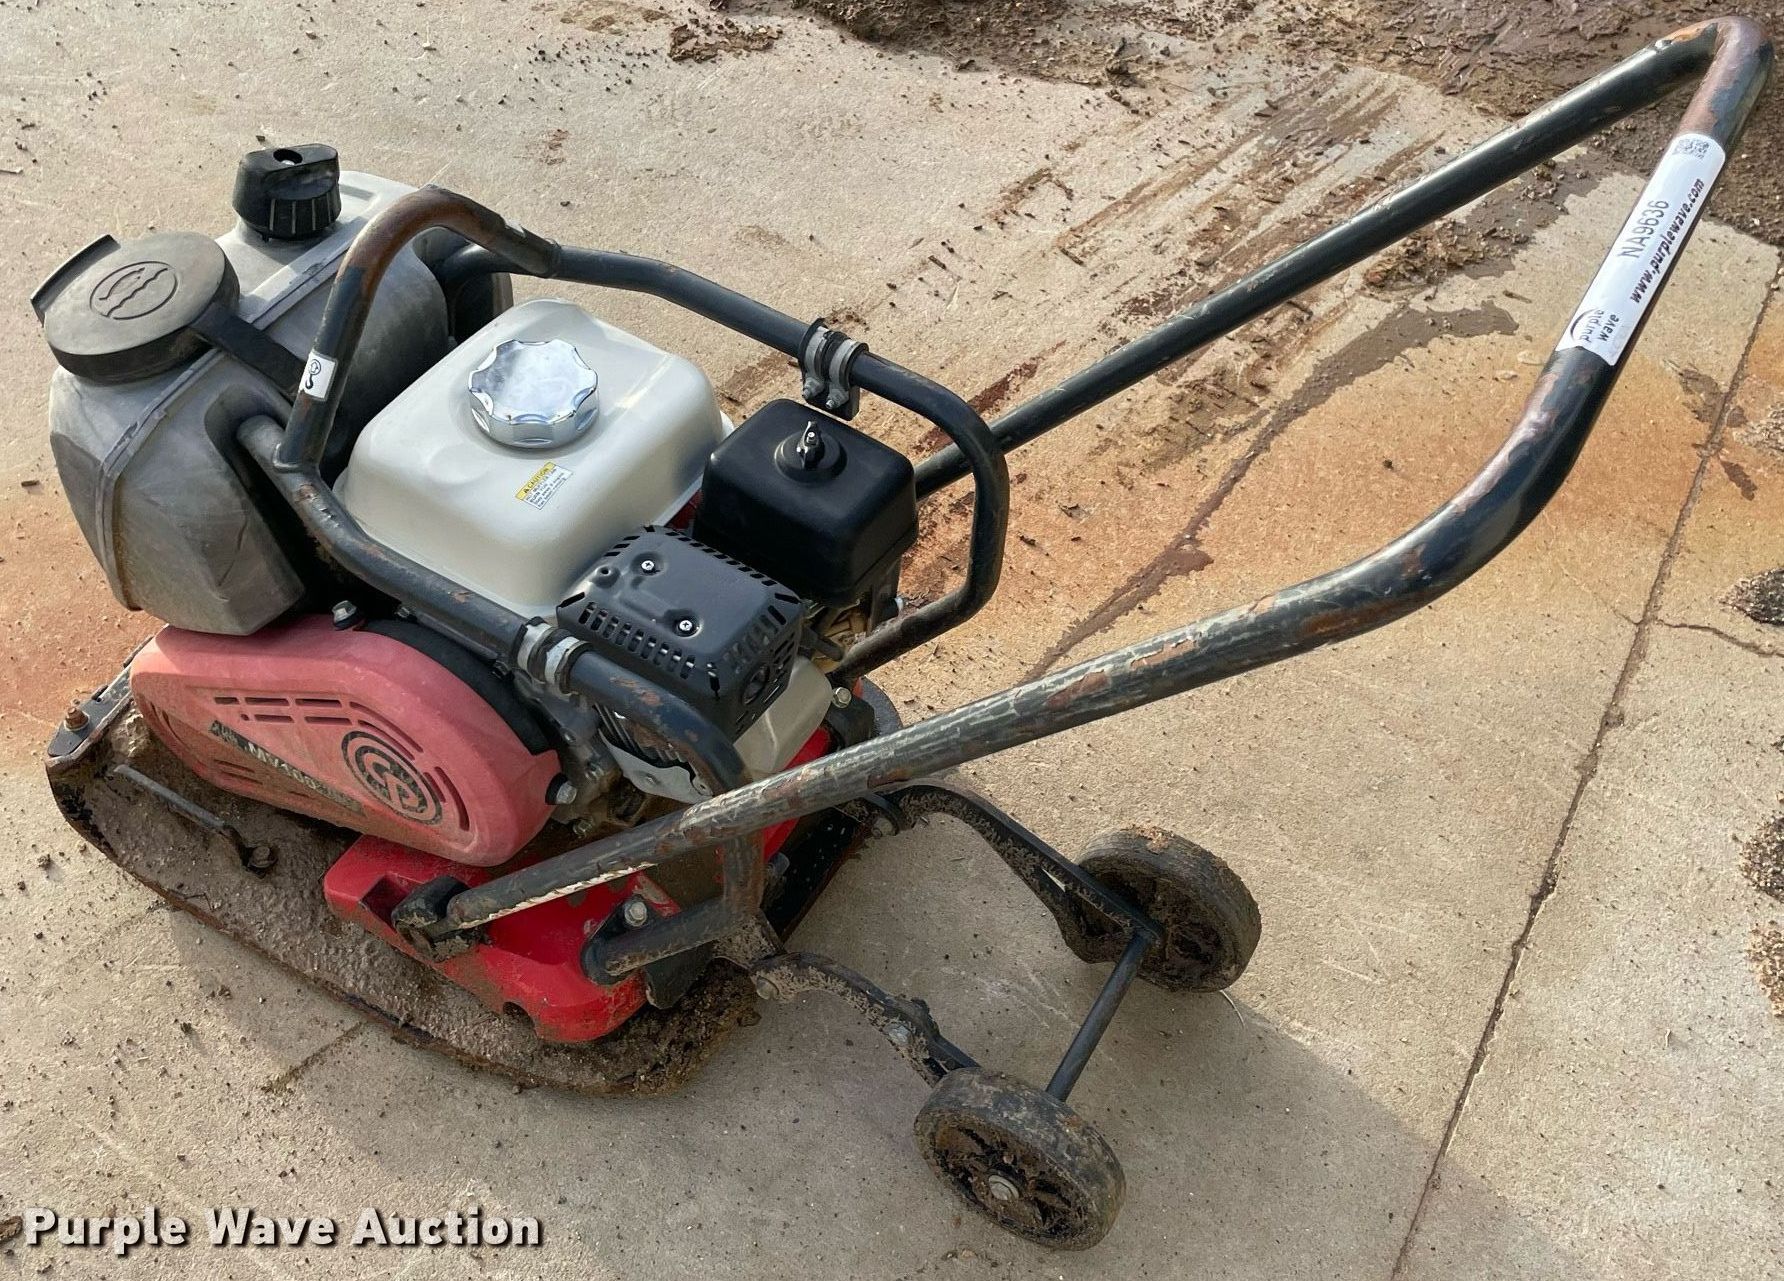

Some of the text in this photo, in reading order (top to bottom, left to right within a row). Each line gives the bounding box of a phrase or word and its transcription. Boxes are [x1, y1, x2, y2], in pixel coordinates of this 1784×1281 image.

[1617, 200, 1670, 258] NA9636
[1630, 178, 1705, 303] www.purplewave.com
[1579, 309, 1604, 343] purple
[1598, 314, 1619, 342] wave
